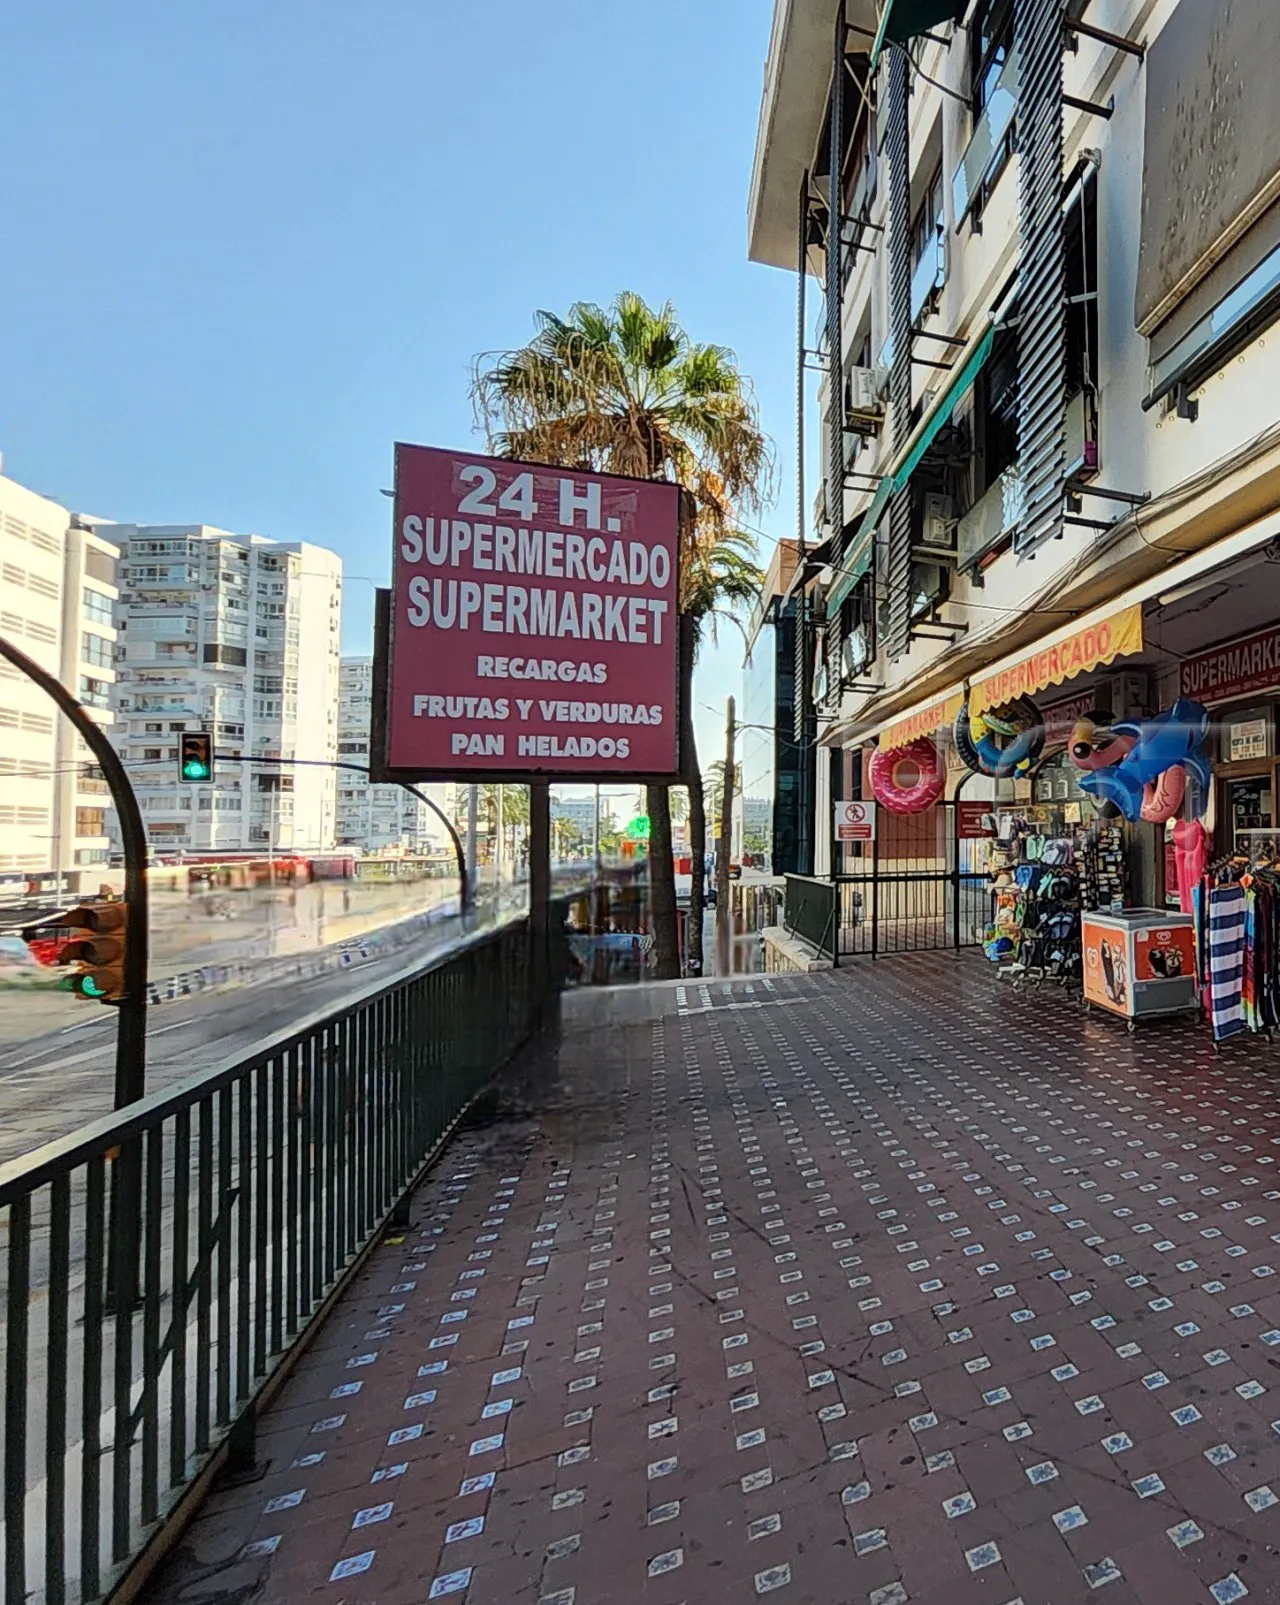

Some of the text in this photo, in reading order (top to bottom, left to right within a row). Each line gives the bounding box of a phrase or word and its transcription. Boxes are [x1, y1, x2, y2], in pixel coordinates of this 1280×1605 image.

[457, 465, 622, 532] 24 H.
[401, 515, 671, 588] SUPERMERCADO
[407, 576, 668, 644] SUPERMARKET
[477, 655, 608, 683] RECARGAS
[985, 622, 1112, 702] SUPERMERCADO
[413, 695, 663, 725] FRUTAS Y VERDURAS
[451, 733, 630, 759] PAN HELADOS
